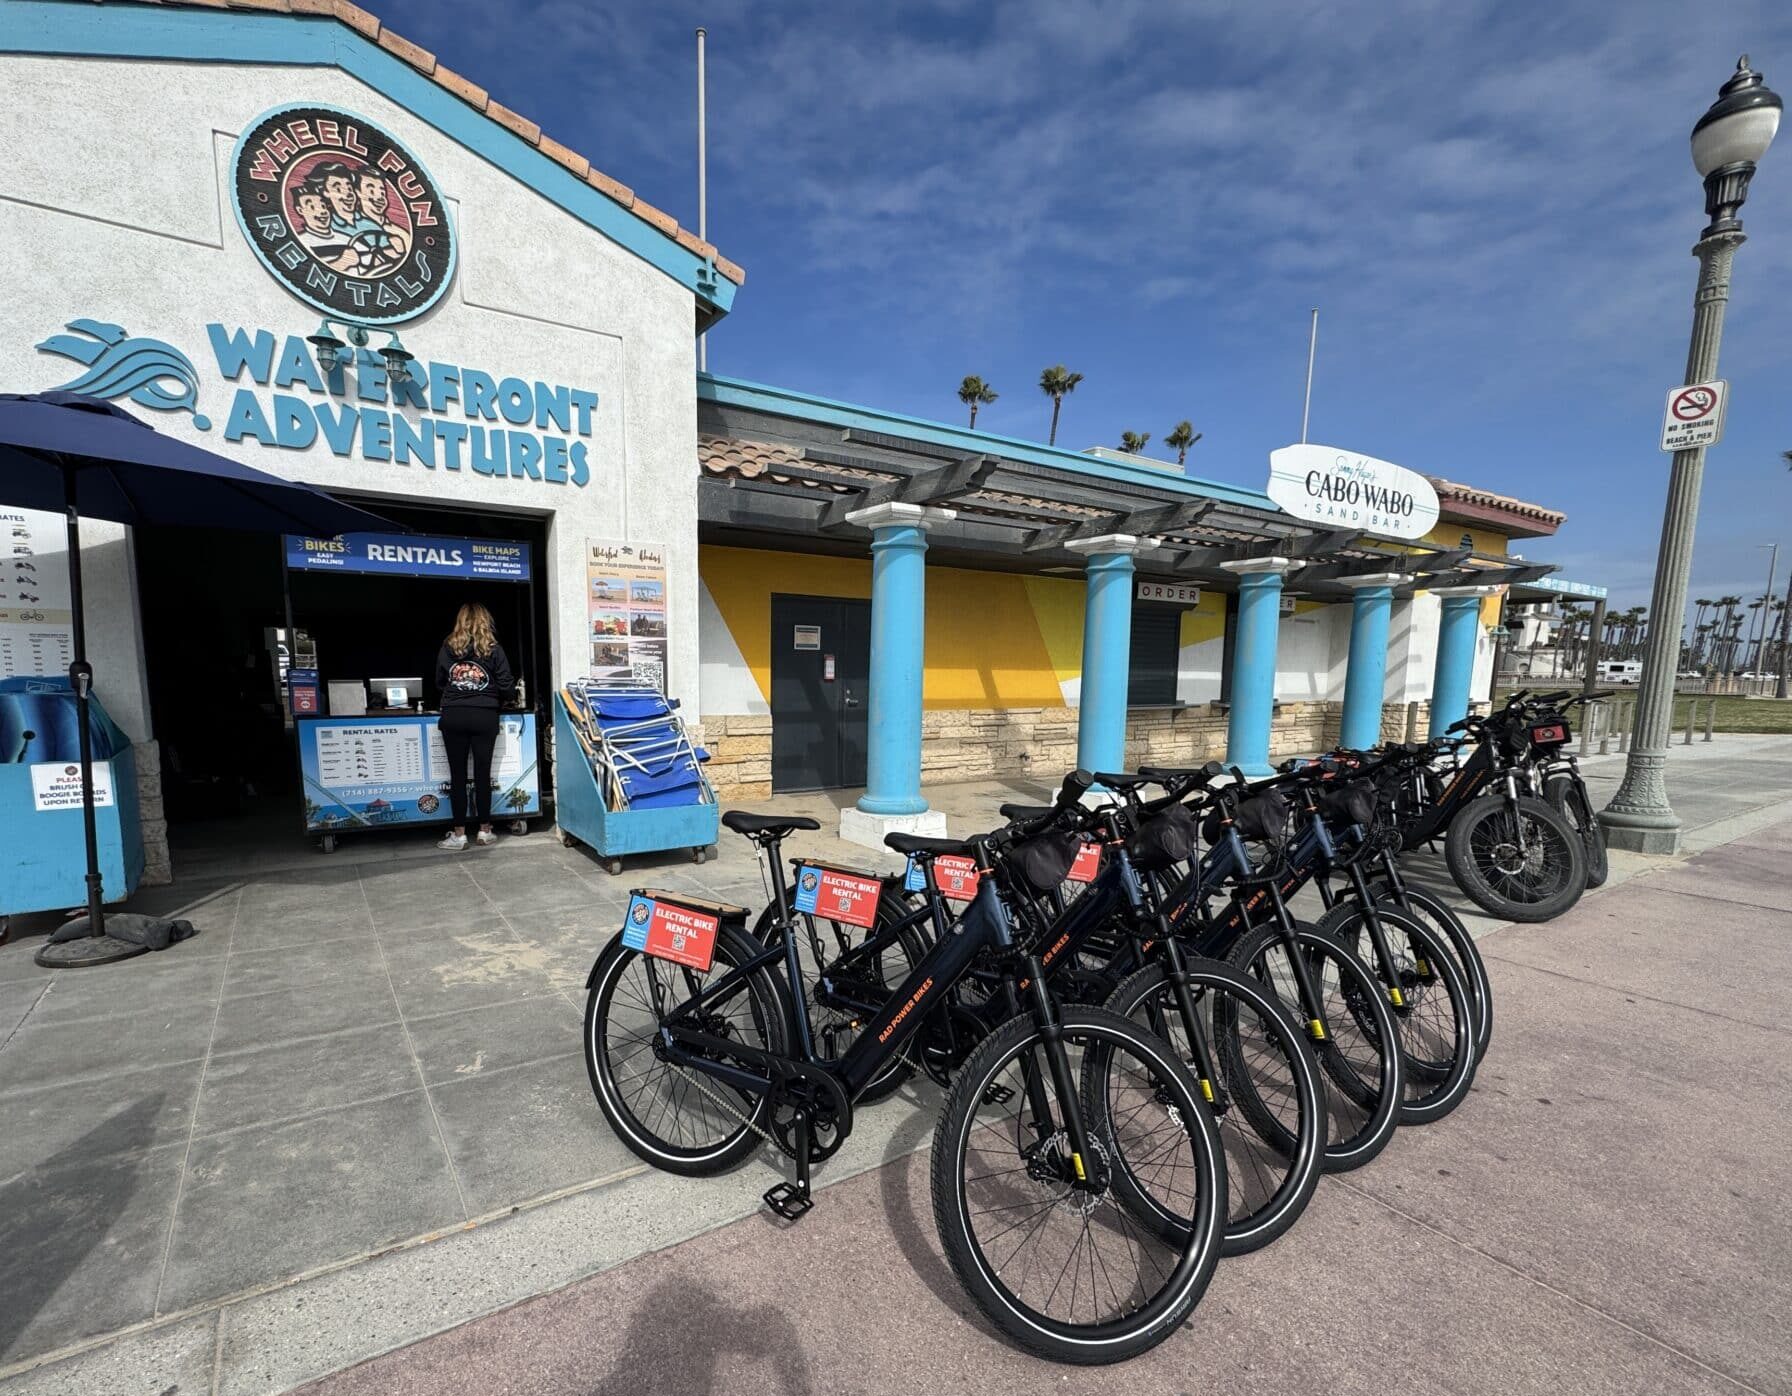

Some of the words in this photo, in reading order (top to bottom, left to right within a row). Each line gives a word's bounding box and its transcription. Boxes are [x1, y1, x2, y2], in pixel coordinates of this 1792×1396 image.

[250, 119, 368, 182] WHEEL
[378, 149, 438, 227] FUN
[256, 214, 432, 307] RENTALS
[206, 323, 598, 437] WATERFRONT
[224, 389, 592, 488] ADVENTURES
[1305, 470, 1360, 505] CABO
[1364, 483, 1414, 517] WABO
[1315, 503, 1360, 521] SAND
[1371, 516, 1400, 530] BAR
[304, 540, 345, 552] BIKES
[367, 543, 464, 566] RENTALS
[472, 545, 494, 554] BIKE
[495, 547, 521, 556] MAPS
[1142, 586, 1197, 600] ORDER
[934, 857, 969, 869] ELECTRIC
[944, 867, 976, 879] RENTAL
[823, 875, 857, 889] ELECTRIC
[858, 883, 877, 894] BIKE
[832, 887, 862, 901] RENTAL
[655, 907, 693, 926] ELECTRIC
[693, 918, 714, 931] BIKE
[665, 921, 698, 939] RENTAL
[1051, 932, 1070, 954] BIKES
[878, 1024, 894, 1044] RAD
[891, 999, 916, 1029] POWER
[913, 976, 934, 1003] BIKES
